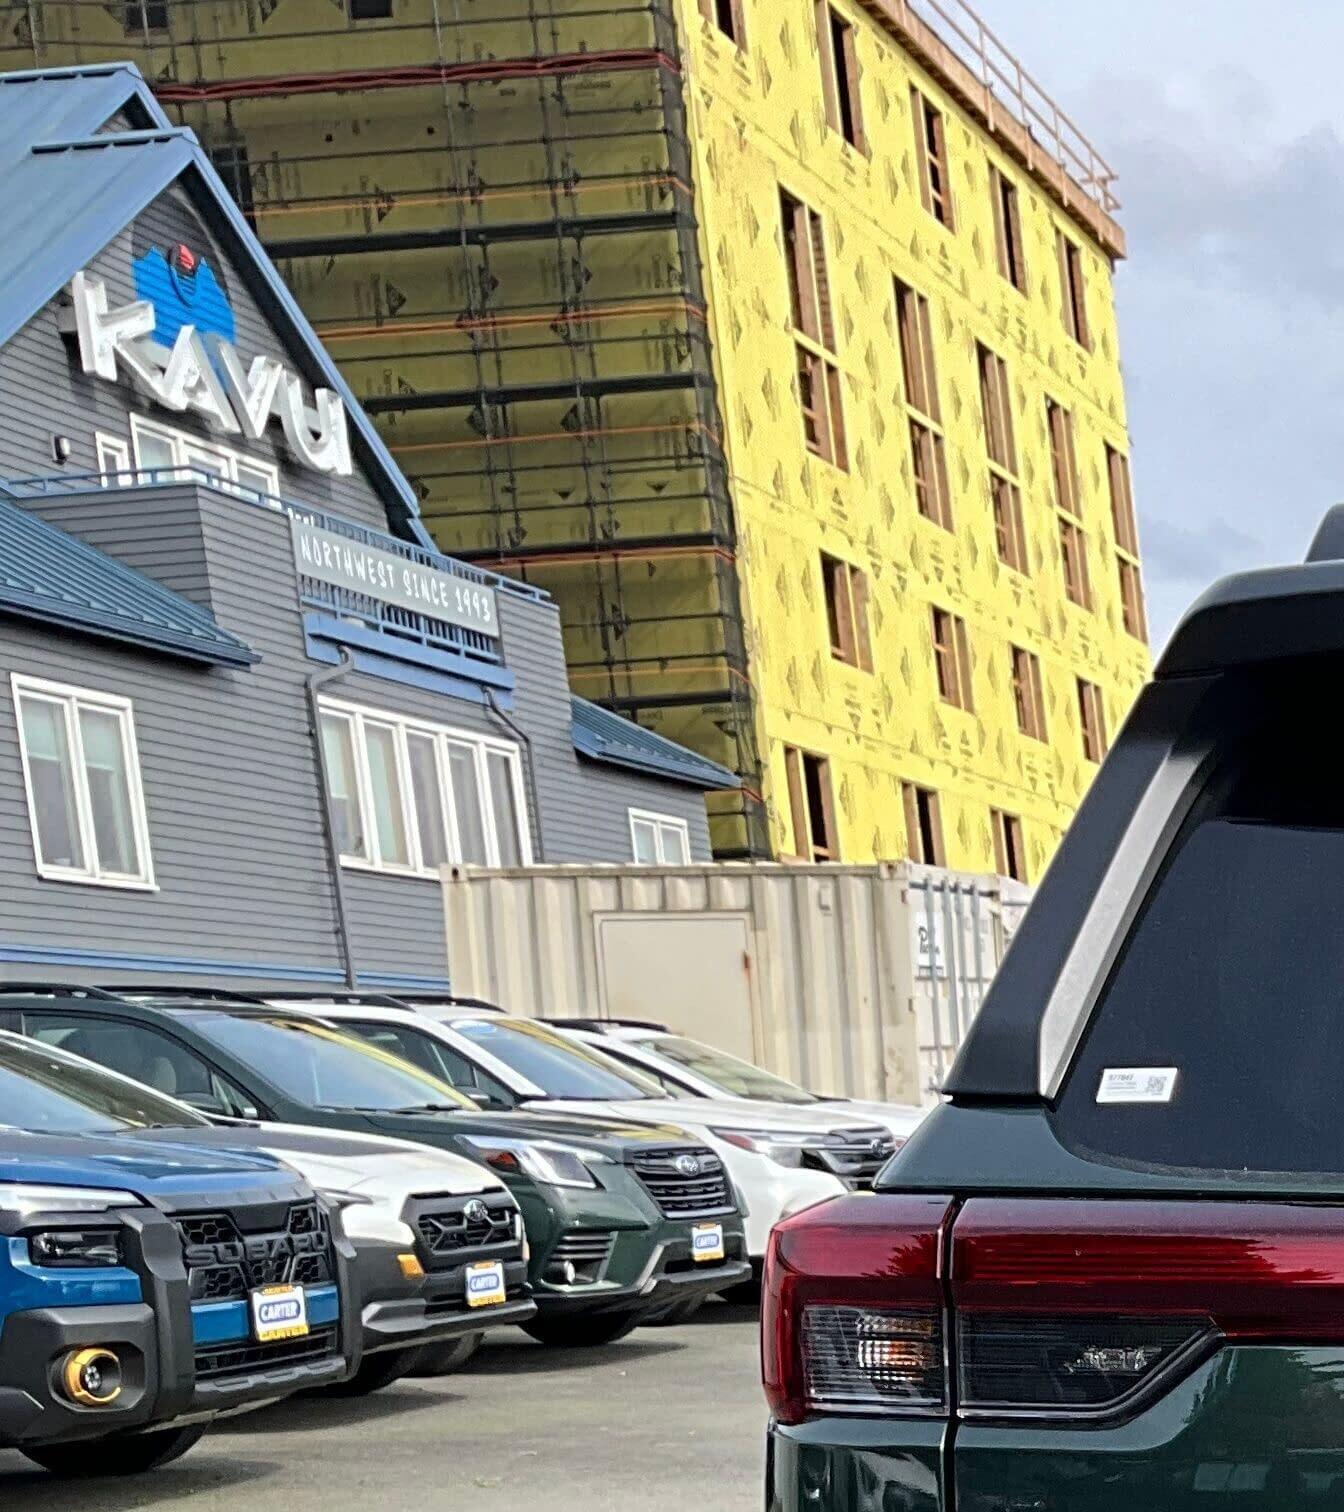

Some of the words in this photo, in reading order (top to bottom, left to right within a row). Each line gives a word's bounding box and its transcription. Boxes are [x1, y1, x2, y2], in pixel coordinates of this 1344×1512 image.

[72, 271, 352, 475] KAVU
[300, 533, 394, 589] NORTHWEST
[403, 568, 449, 608] SINCE
[455, 585, 491, 622] 1993
[260, 1302, 298, 1320] CARTER
